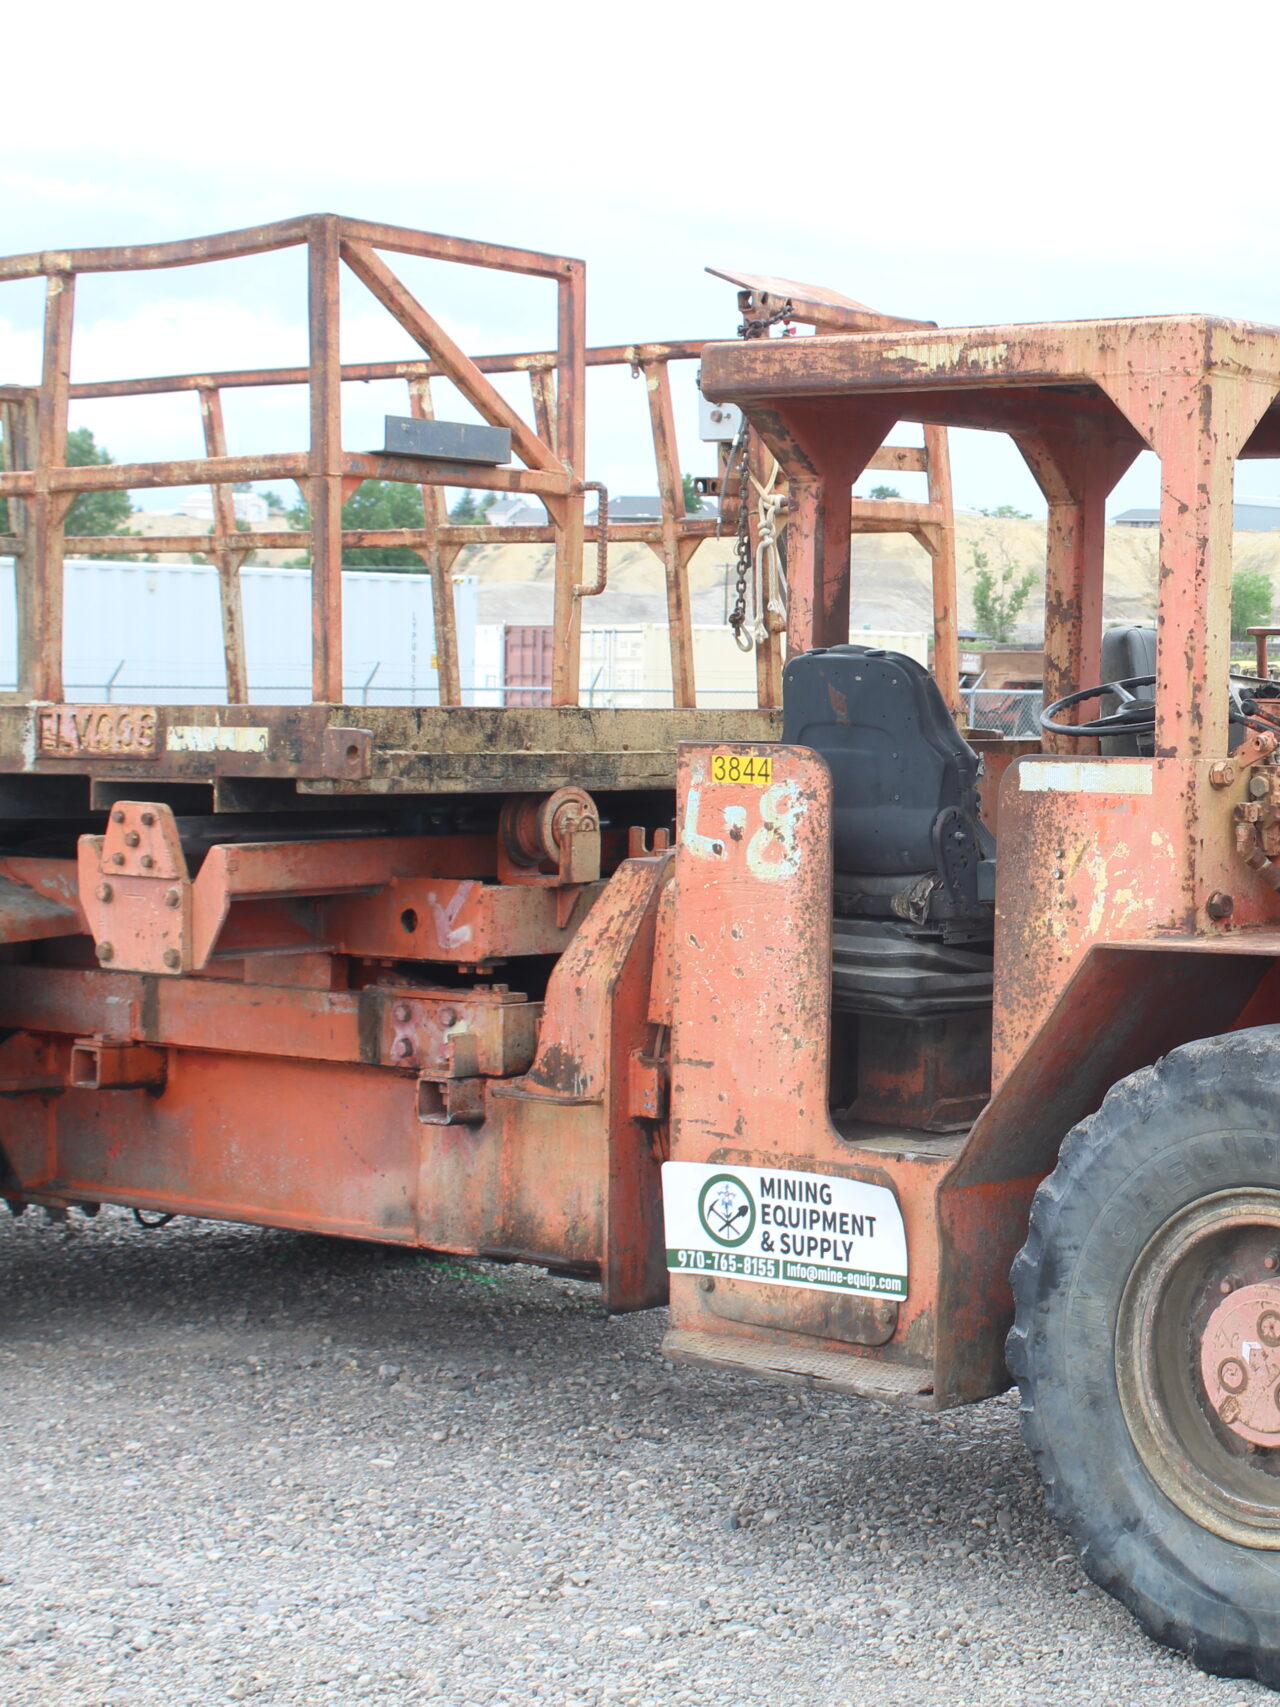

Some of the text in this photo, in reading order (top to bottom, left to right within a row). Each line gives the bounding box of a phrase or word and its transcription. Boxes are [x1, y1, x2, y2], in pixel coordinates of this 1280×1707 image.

[714, 756, 770, 782] 3844
[760, 1176, 832, 1206] MINING
[761, 1203, 876, 1238] EQUIPMENT
[760, 1230, 854, 1263] & SUPPLY
[678, 1250, 902, 1292] 970-765-8155 Info@mine-equip.com
